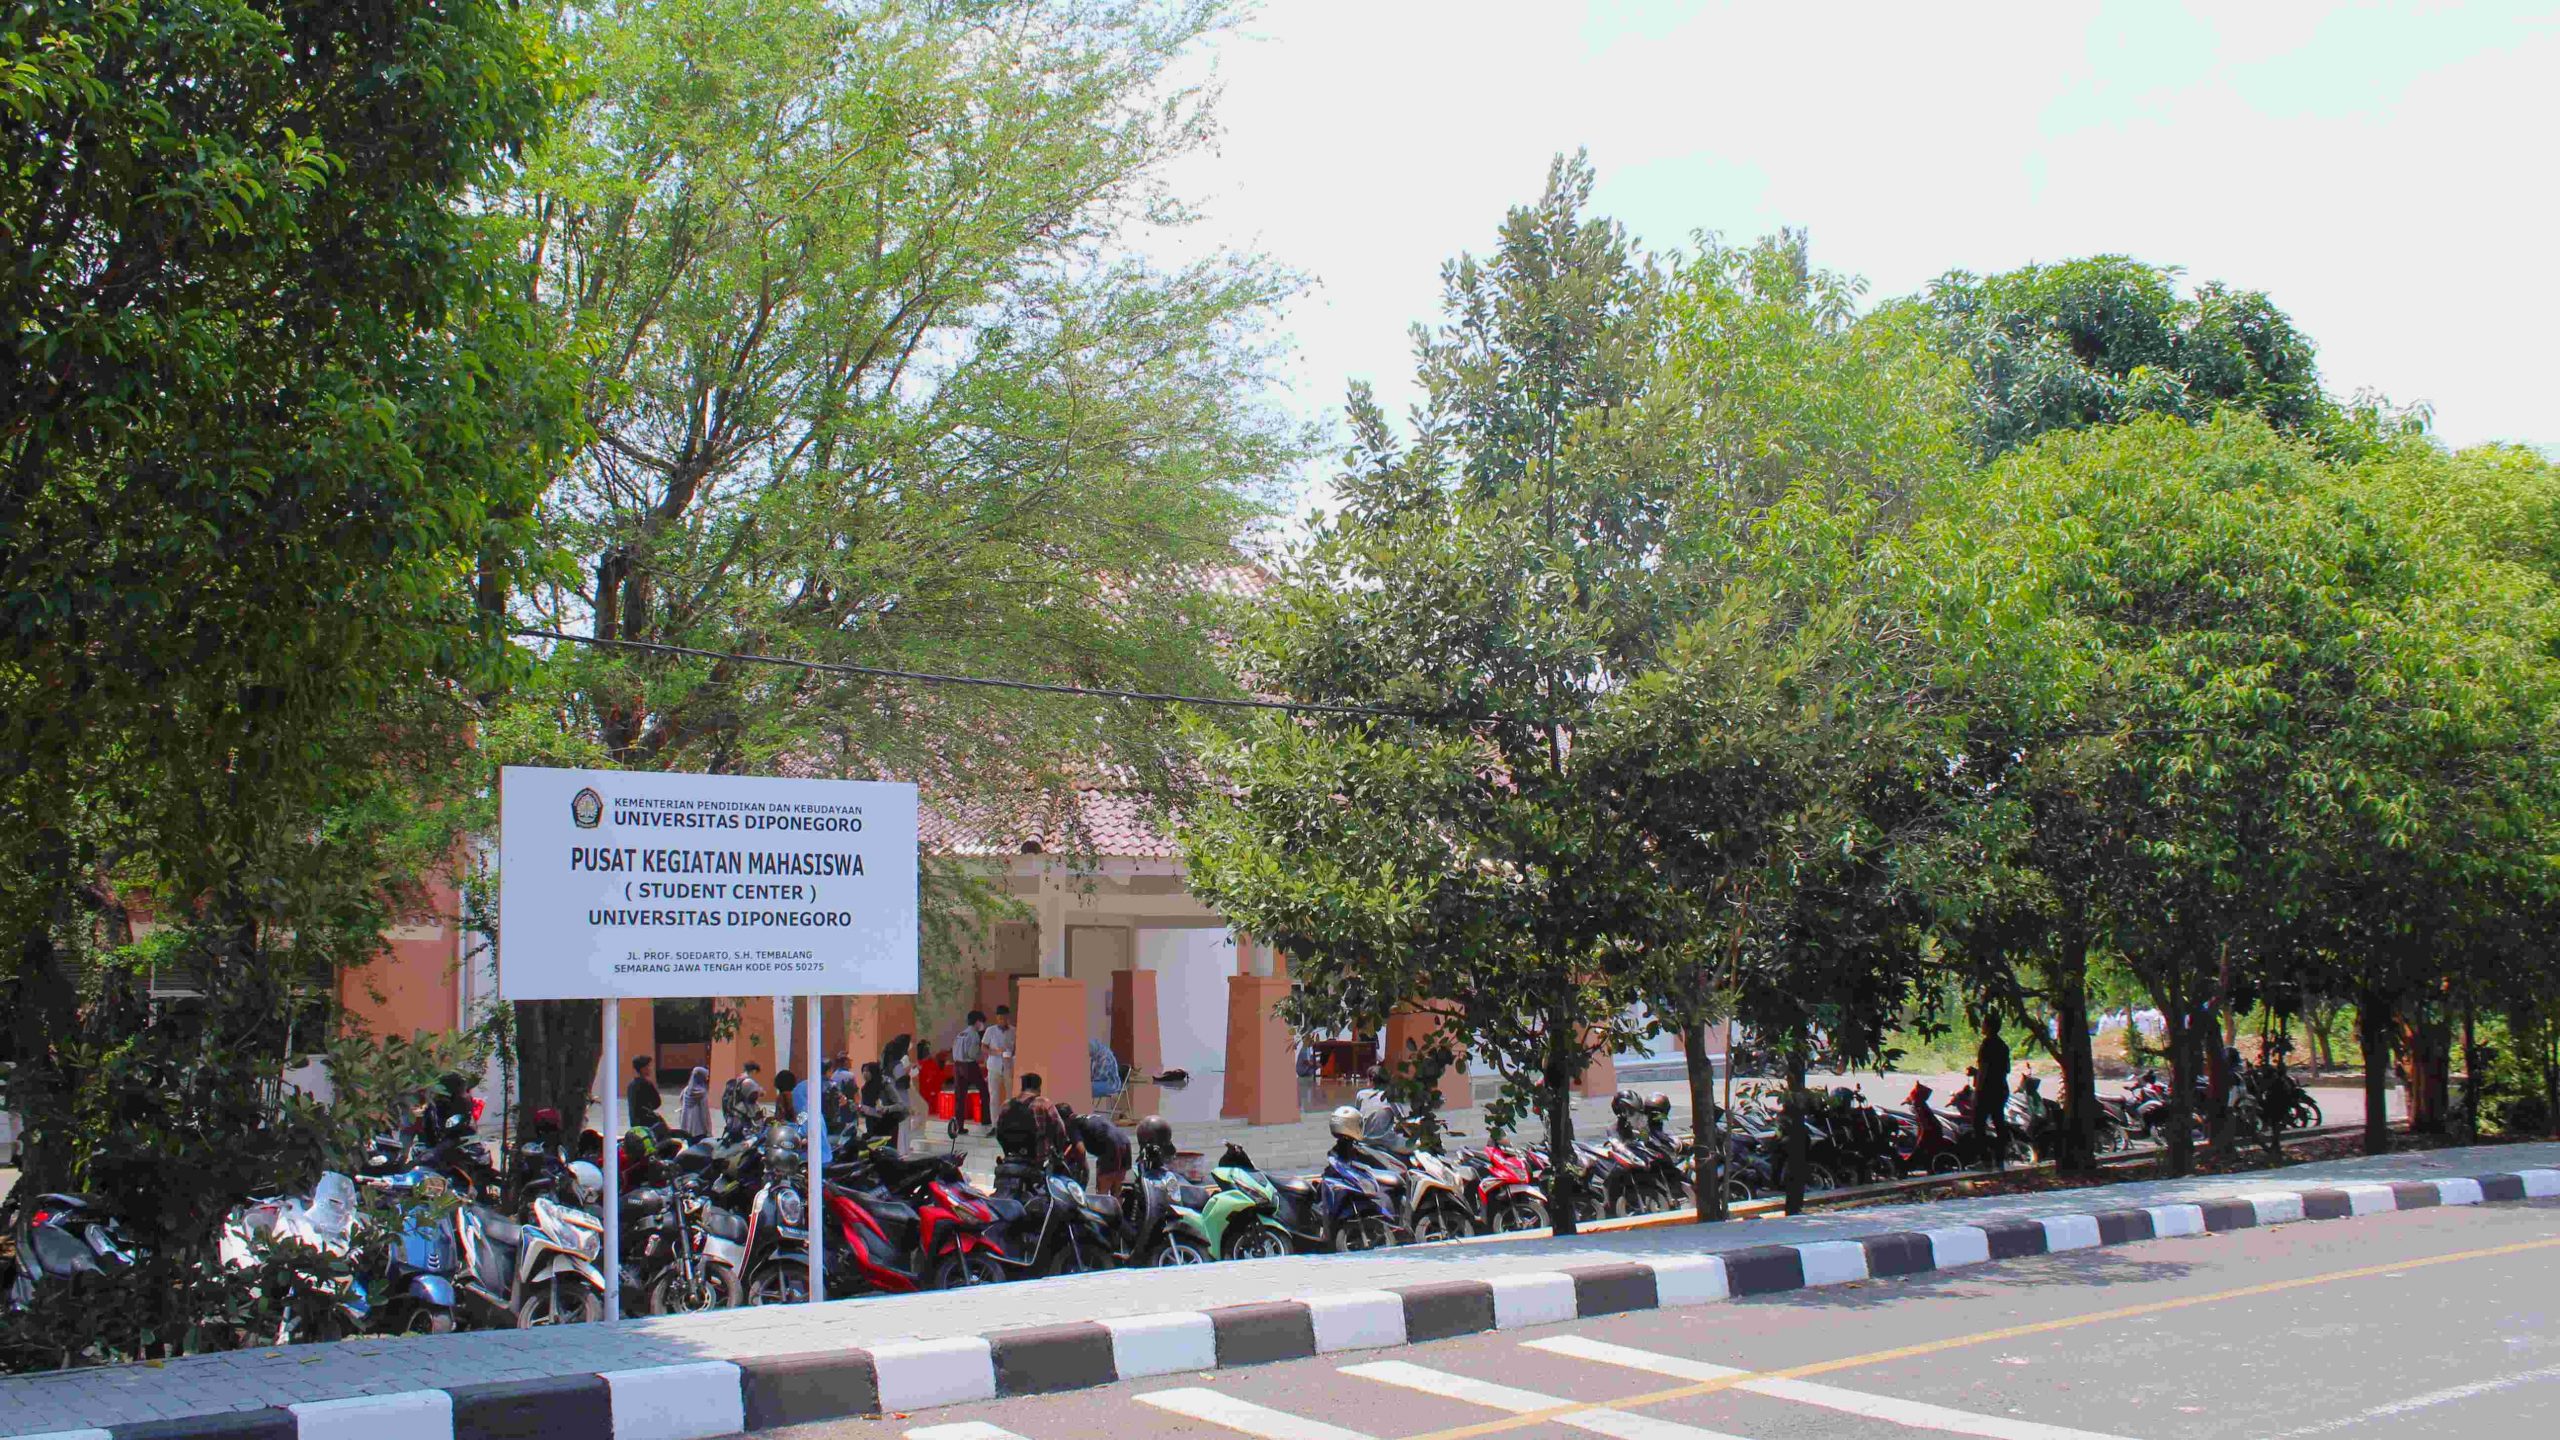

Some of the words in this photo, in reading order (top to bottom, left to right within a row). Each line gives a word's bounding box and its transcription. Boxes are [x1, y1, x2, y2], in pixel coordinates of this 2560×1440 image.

[614, 798, 694, 809] KEMENTERIAN
[697, 801, 765, 812] PENDIDIKAN
[769, 803, 791, 813] DAN
[794, 804, 862, 815] KEBUDAYAAN
[614, 811, 739, 829] UNIVERSITAS
[745, 815, 862, 832] DIPONEGORO
[572, 847, 636, 872] PUSAT
[643, 849, 741, 874] KEGIATAN
[749, 852, 864, 876] MAHASISWA
[625, 882, 632, 902] (
[639, 882, 727, 899] STUDENT
[732, 884, 804, 901] CENTER
[810, 884, 816, 904] )
[589, 910, 721, 926] UNIVERSITAS
[727, 911, 851, 927] DIPONEGORO
[626, 951, 640, 961] JL.
[644, 951, 672, 960] PROF.
[676, 951, 732, 961] SOEDARTO,
[734, 951, 753, 960] S.H.
[756, 950, 813, 960] TEMBALANG
[614, 963, 671, 973] SEMARANG
[673, 963, 700, 973] JAWA
[704, 963, 743, 972] TENGAH
[745, 963, 772, 972] KODE
[774, 962, 794, 972] POS
[795, 962, 824, 971] 50275
